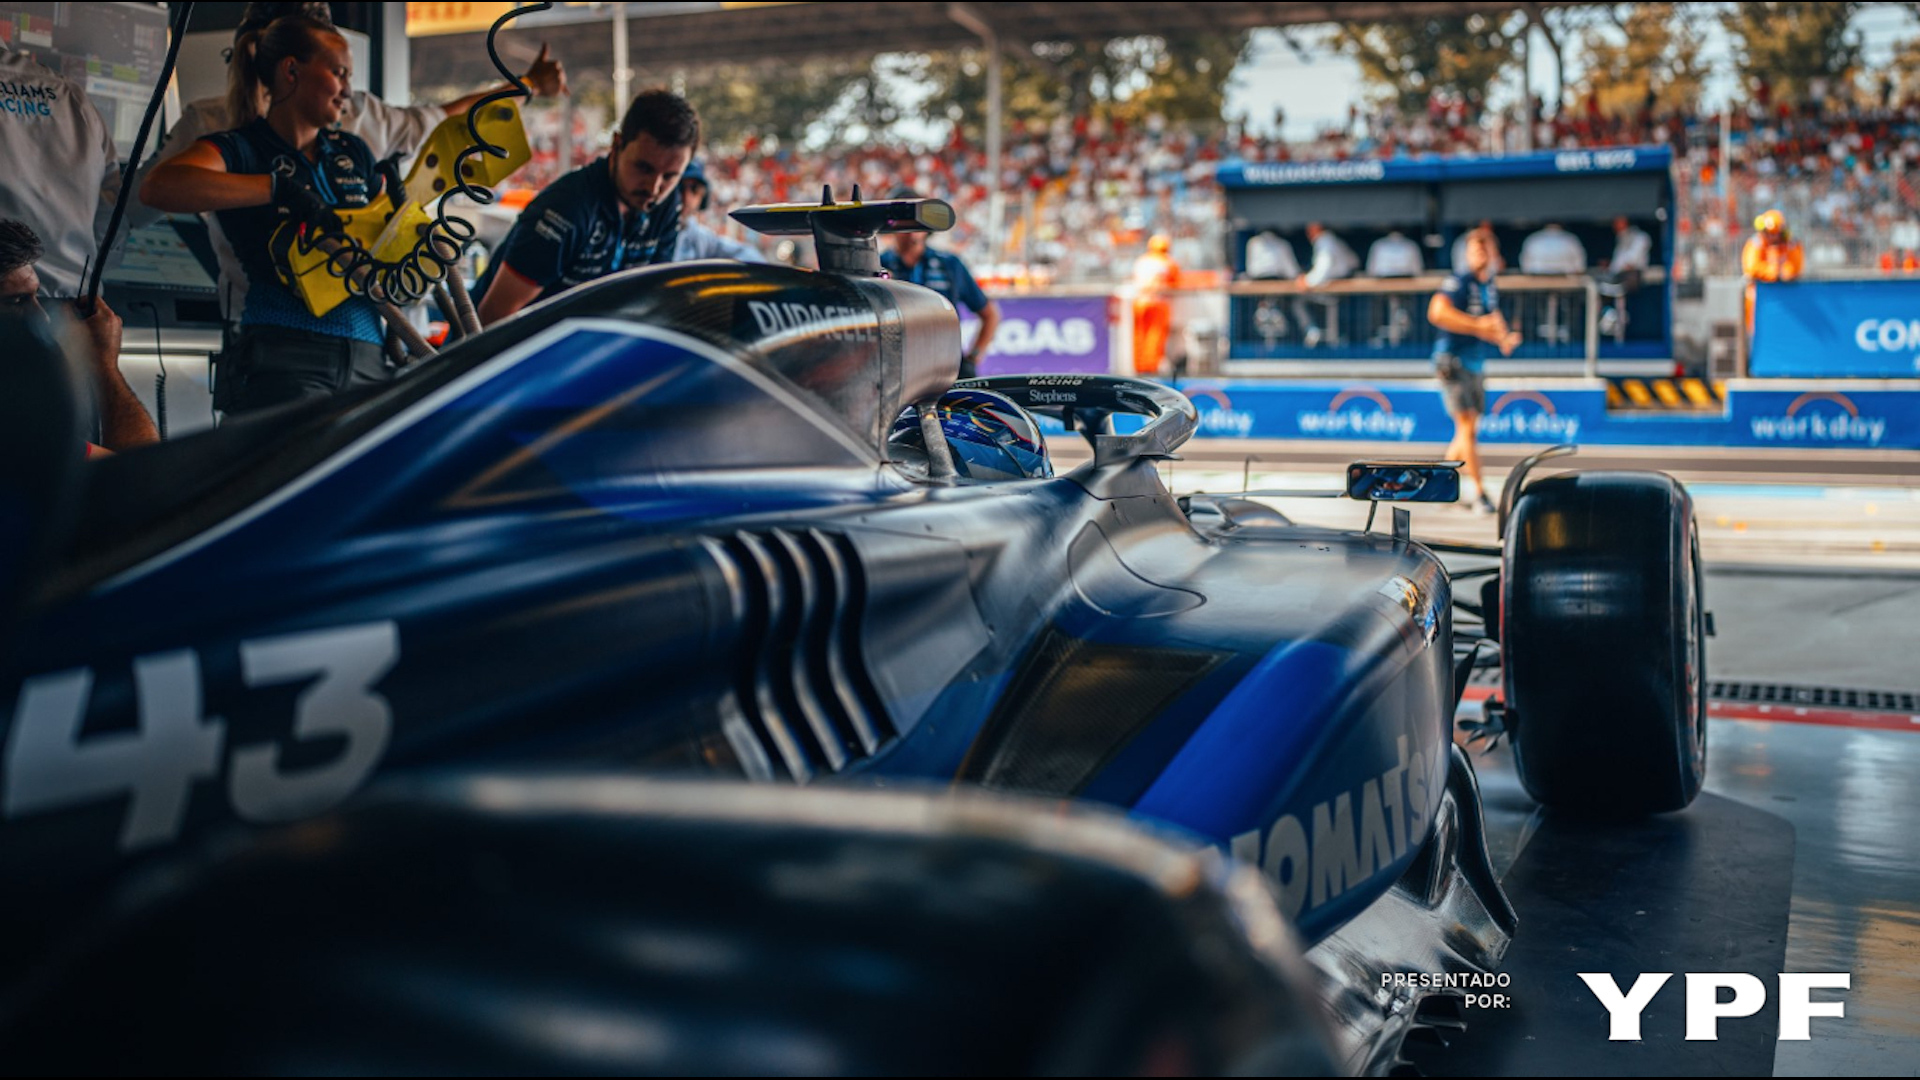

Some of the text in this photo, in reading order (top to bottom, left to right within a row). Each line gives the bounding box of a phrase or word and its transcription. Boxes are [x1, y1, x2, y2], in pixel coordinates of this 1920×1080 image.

[0, 81, 57, 100] LIAMS
[961, 317, 1096, 357] GAS
[1028, 378, 1083, 386] RACING
[1029, 389, 1077, 404] Stephens
[1299, 405, 1416, 442] workday
[1751, 409, 1886, 447] workday
[6, 619, 402, 853] 43
